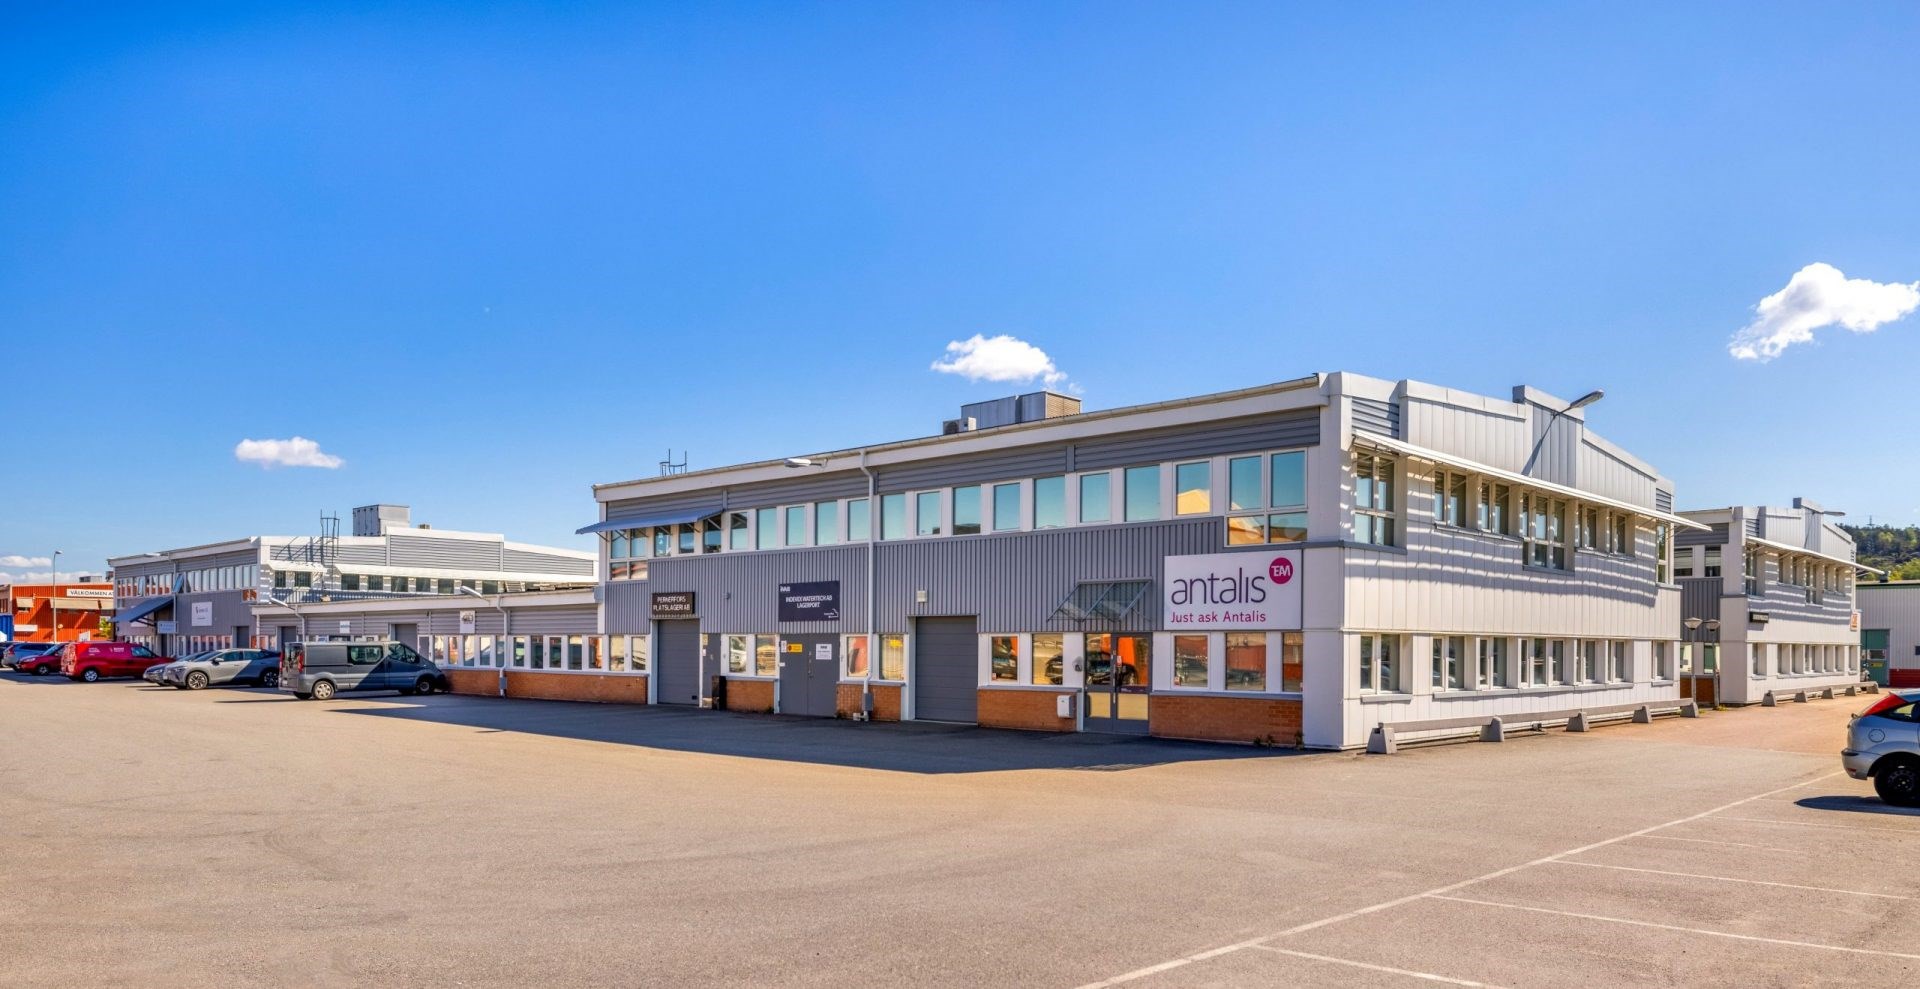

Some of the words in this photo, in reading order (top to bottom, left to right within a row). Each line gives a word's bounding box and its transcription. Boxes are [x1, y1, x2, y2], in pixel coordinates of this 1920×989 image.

[1171, 566, 1266, 605] antalis
[1171, 611, 1193, 623] Just
[1198, 611, 1218, 622] ask
[1223, 610, 1266, 622] Antalis
